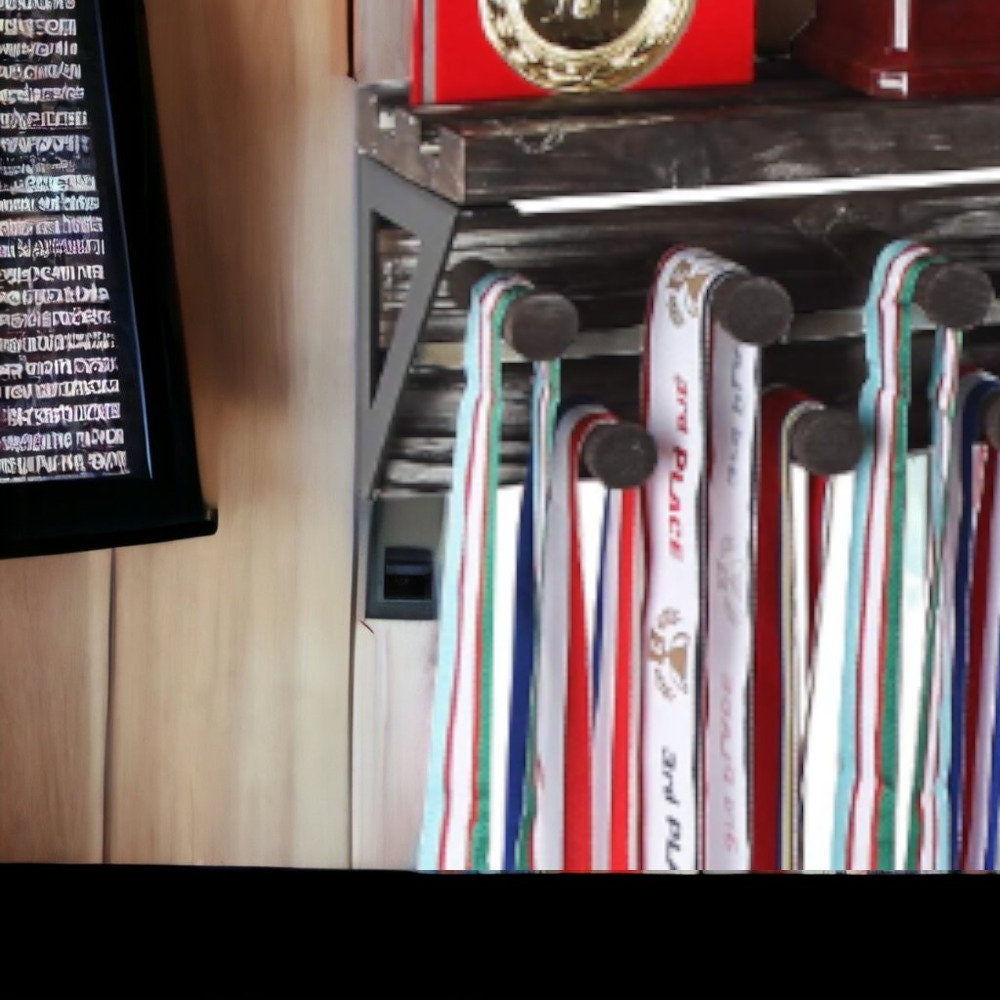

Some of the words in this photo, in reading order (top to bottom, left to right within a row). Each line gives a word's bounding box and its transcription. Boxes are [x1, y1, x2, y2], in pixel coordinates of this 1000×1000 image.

[675, 374, 688, 435] 3rd
[669, 446, 687, 561] PLACE
[662, 746, 680, 806] 3rd
